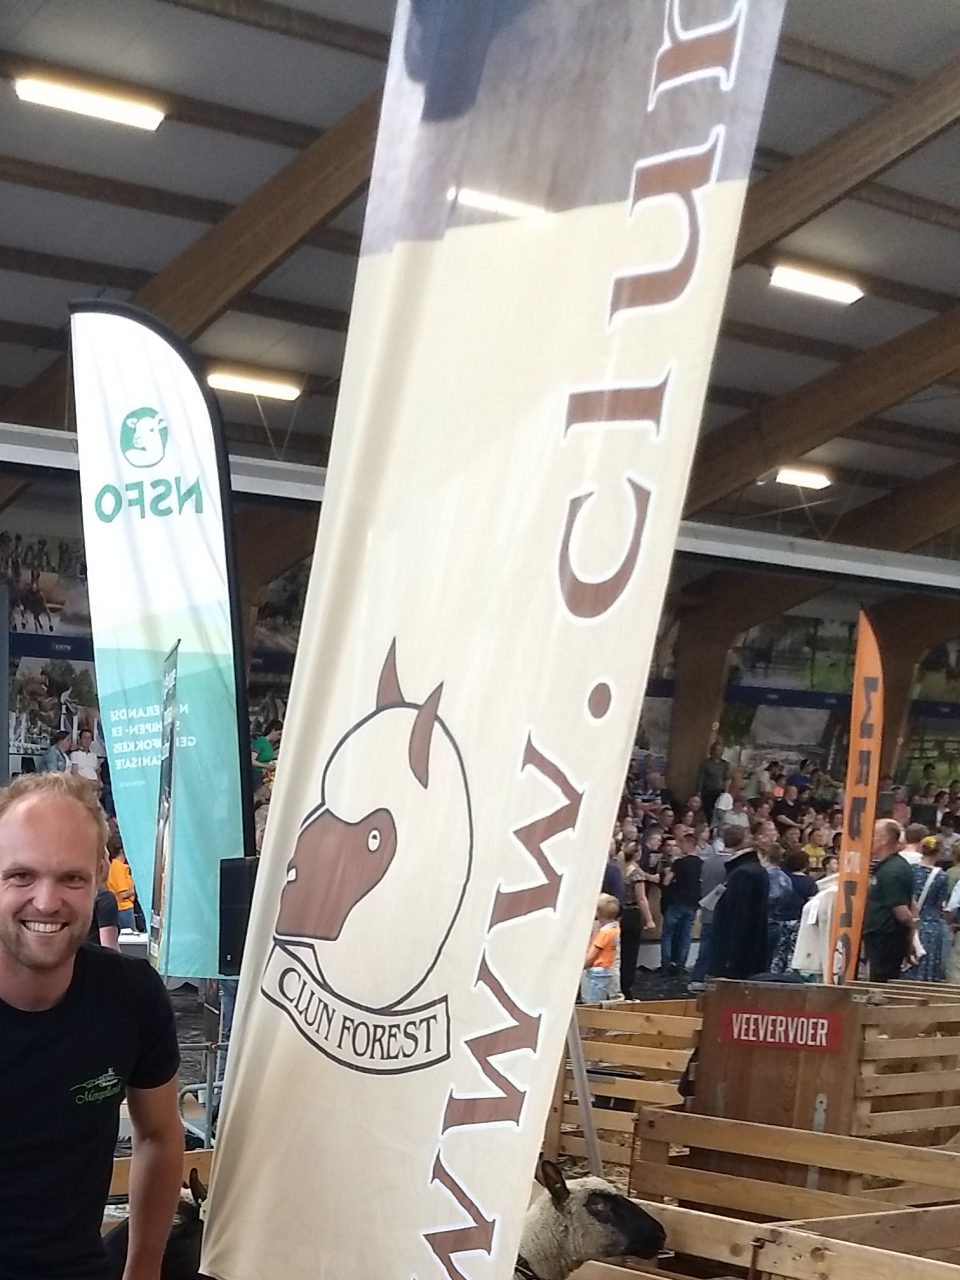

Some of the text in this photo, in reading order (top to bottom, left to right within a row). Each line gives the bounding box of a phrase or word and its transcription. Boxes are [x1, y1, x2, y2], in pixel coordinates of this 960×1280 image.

[278, 968, 438, 1060] CLUN FOREST
[732, 1013, 828, 1046] VEEVERVOER
